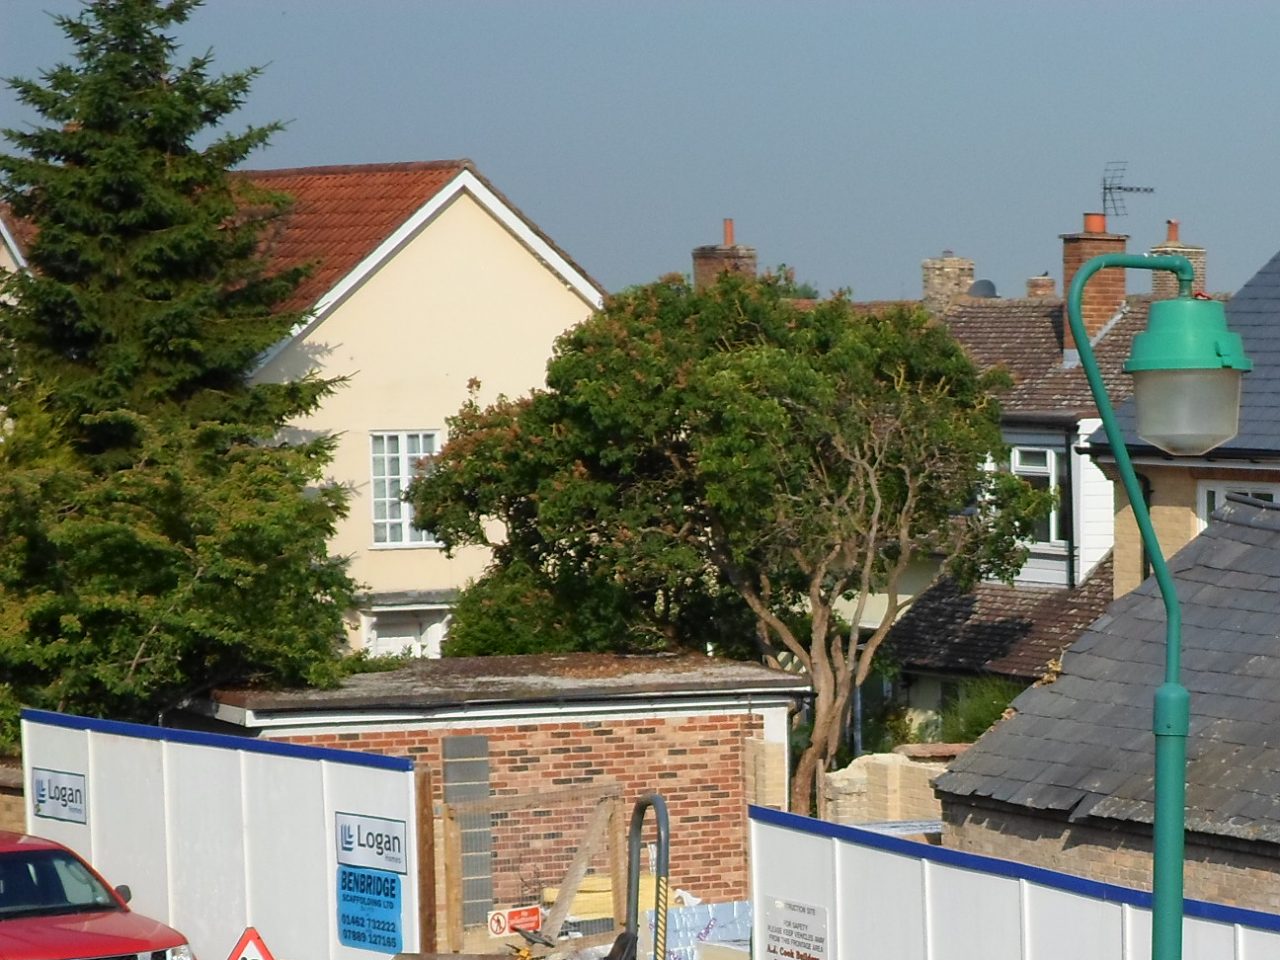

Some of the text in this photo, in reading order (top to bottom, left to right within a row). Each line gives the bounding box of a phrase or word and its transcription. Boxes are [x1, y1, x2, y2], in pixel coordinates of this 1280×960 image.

[48, 779, 82, 807] Logan
[357, 824, 401, 856] Logan
[341, 870, 396, 899] BENBRIDGE
[382, 900, 394, 910] LTD
[779, 946, 795, 959] Cook
